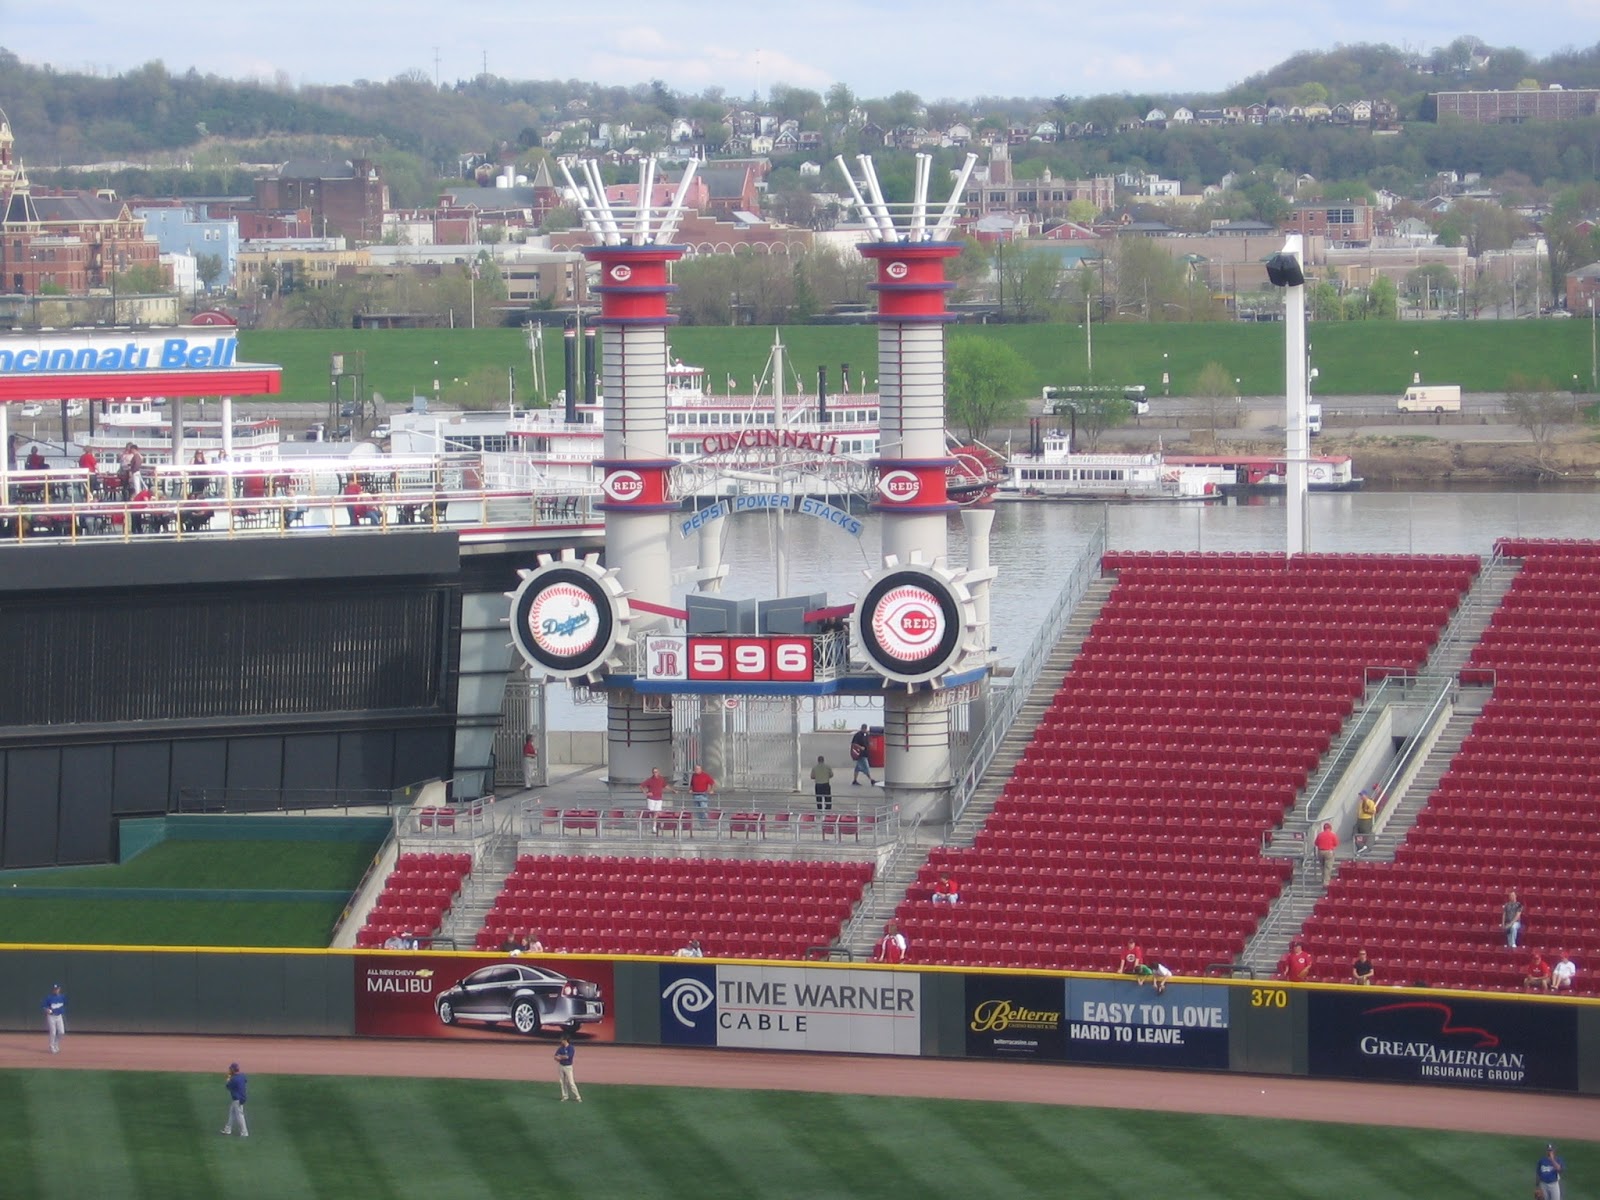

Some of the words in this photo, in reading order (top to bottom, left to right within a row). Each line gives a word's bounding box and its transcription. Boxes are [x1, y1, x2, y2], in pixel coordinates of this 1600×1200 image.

[161, 338, 236, 368] Bell
[702, 428, 838, 455] CINCINNATI
[613, 481, 643, 491] REDS
[889, 481, 920, 491] REDS
[682, 503, 724, 536] PEPSI
[736, 494, 790, 510] POWER
[802, 500, 861, 534] STACKS
[542, 610, 590, 637] Dodgers
[903, 618, 936, 629] REDS
[652, 651, 683, 677] JR
[367, 977, 432, 993] MALIBU
[719, 980, 787, 1006] TIME
[794, 983, 915, 1012] WARNER
[1251, 989, 1288, 1008] 370
[719, 1012, 807, 1032] CABLE
[970, 999, 1059, 1032] Belterra
[1083, 1001, 1135, 1024] EASY
[1139, 1004, 1165, 1026] TO
[1172, 1006, 1228, 1029] LOVE.
[1070, 1023, 1110, 1041] HARD
[1114, 1026, 1133, 1042] TO
[1136, 1027, 1185, 1045] LEAVE.
[1421, 1065, 1484, 1079] INSURANCE
[1488, 1069, 1525, 1082] GROUP
